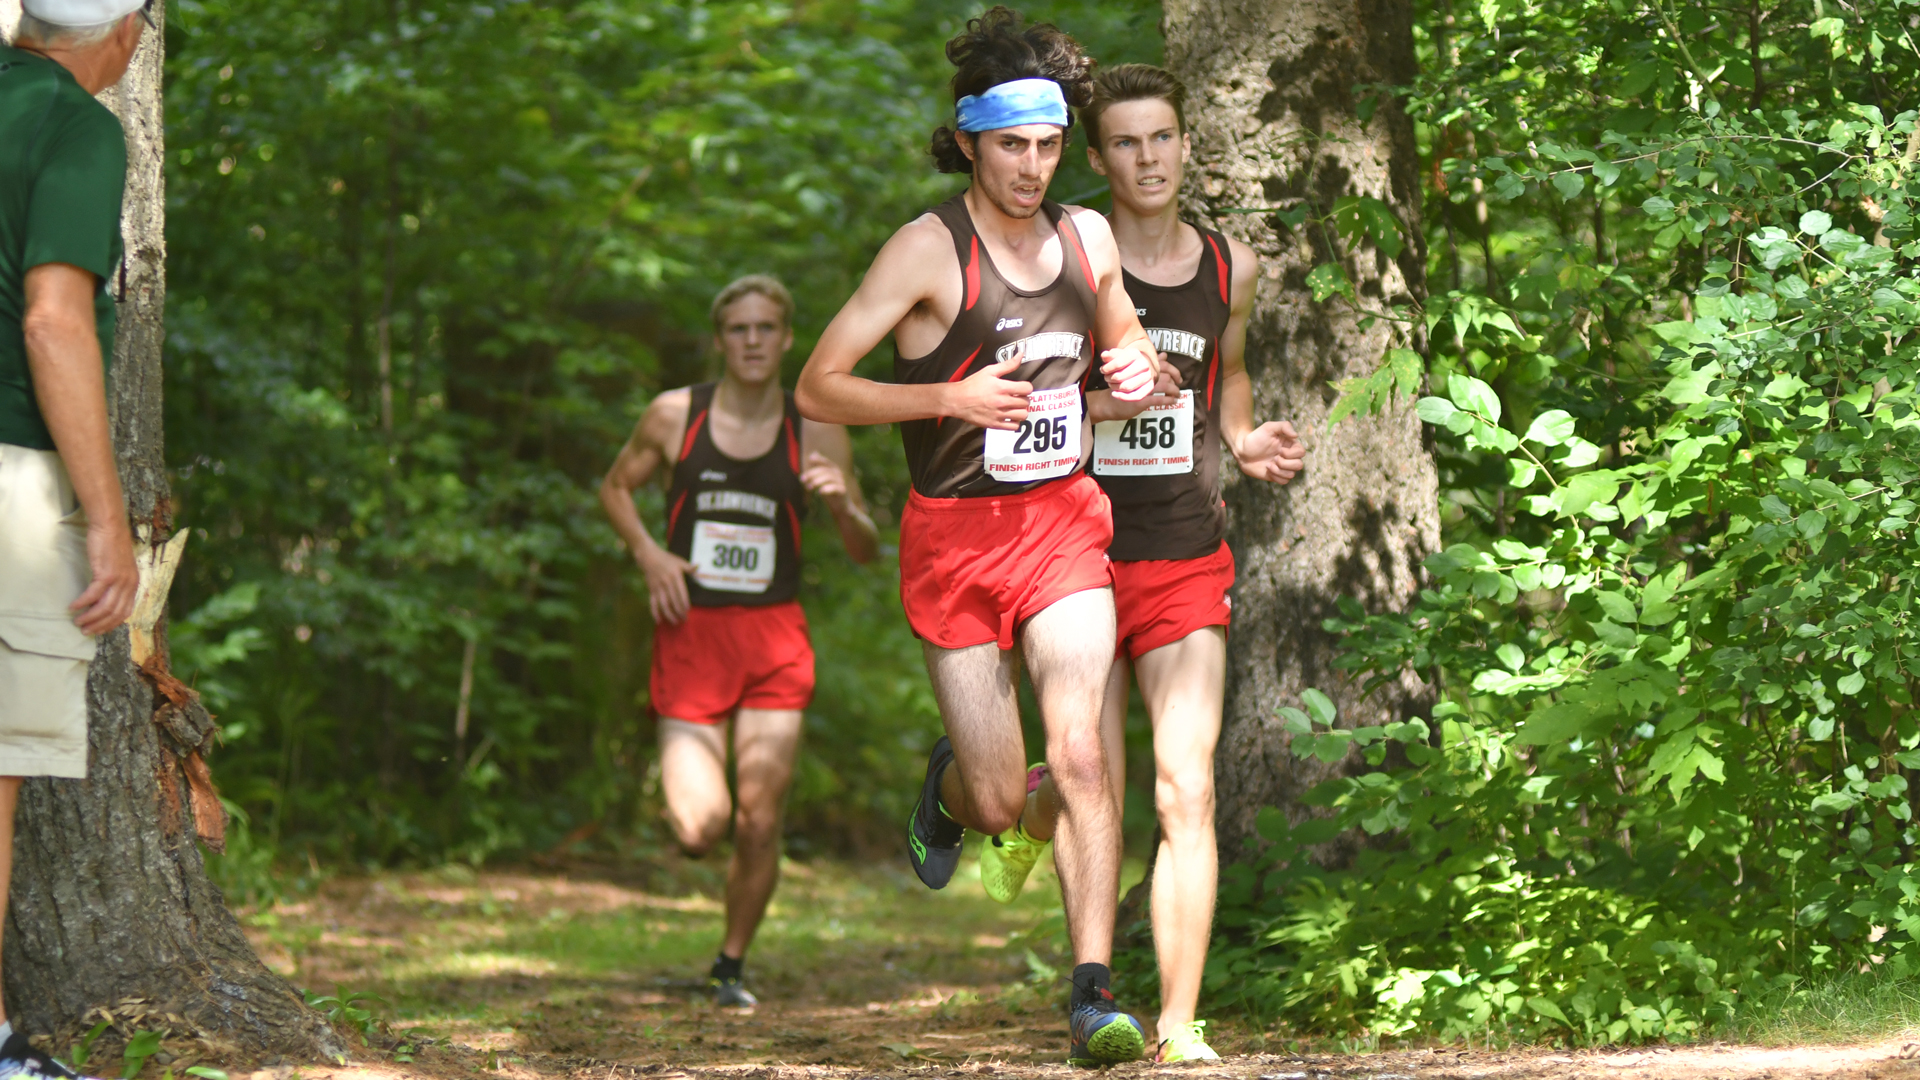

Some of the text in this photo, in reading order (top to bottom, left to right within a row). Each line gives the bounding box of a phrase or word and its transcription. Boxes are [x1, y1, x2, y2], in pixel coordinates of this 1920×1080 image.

[1013, 415, 1067, 454] 295
[1119, 416, 1176, 450] 458
[989, 455, 1079, 472] FINISH RIGHT TIMING
[1098, 455, 1190, 466] FINISH RIGHT TIMING
[712, 543, 758, 571] 300
